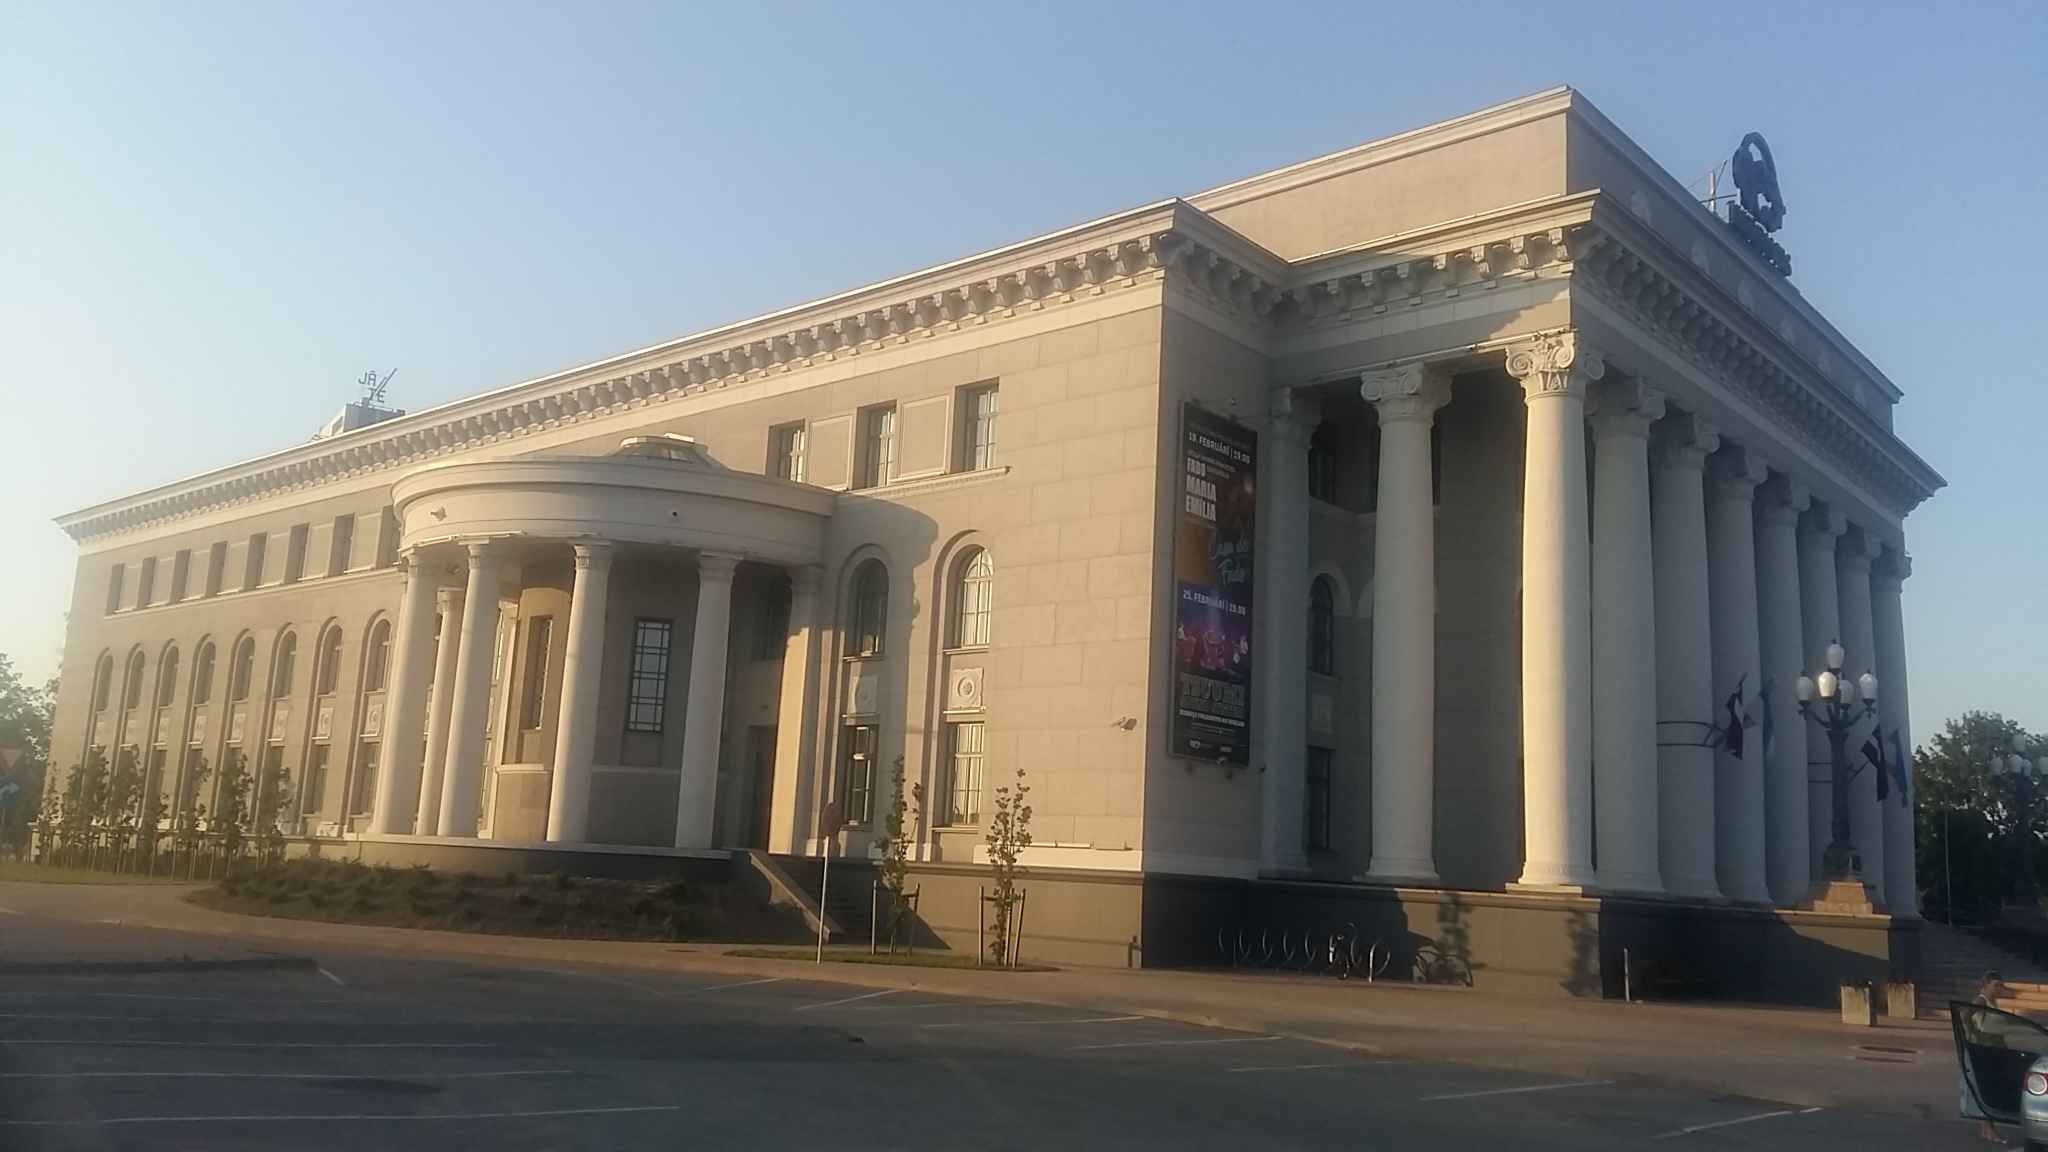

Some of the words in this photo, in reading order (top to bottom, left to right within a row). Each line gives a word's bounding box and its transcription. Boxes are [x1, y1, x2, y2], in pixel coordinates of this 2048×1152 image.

[1188, 432, 1198, 443] 19.
[1233, 450, 1251, 464] 19.00
[1187, 457, 1206, 477] FADO
[1186, 475, 1217, 502] MARIA
[1182, 589, 1193, 601] 25.
[1229, 602, 1246, 616] 19.00
